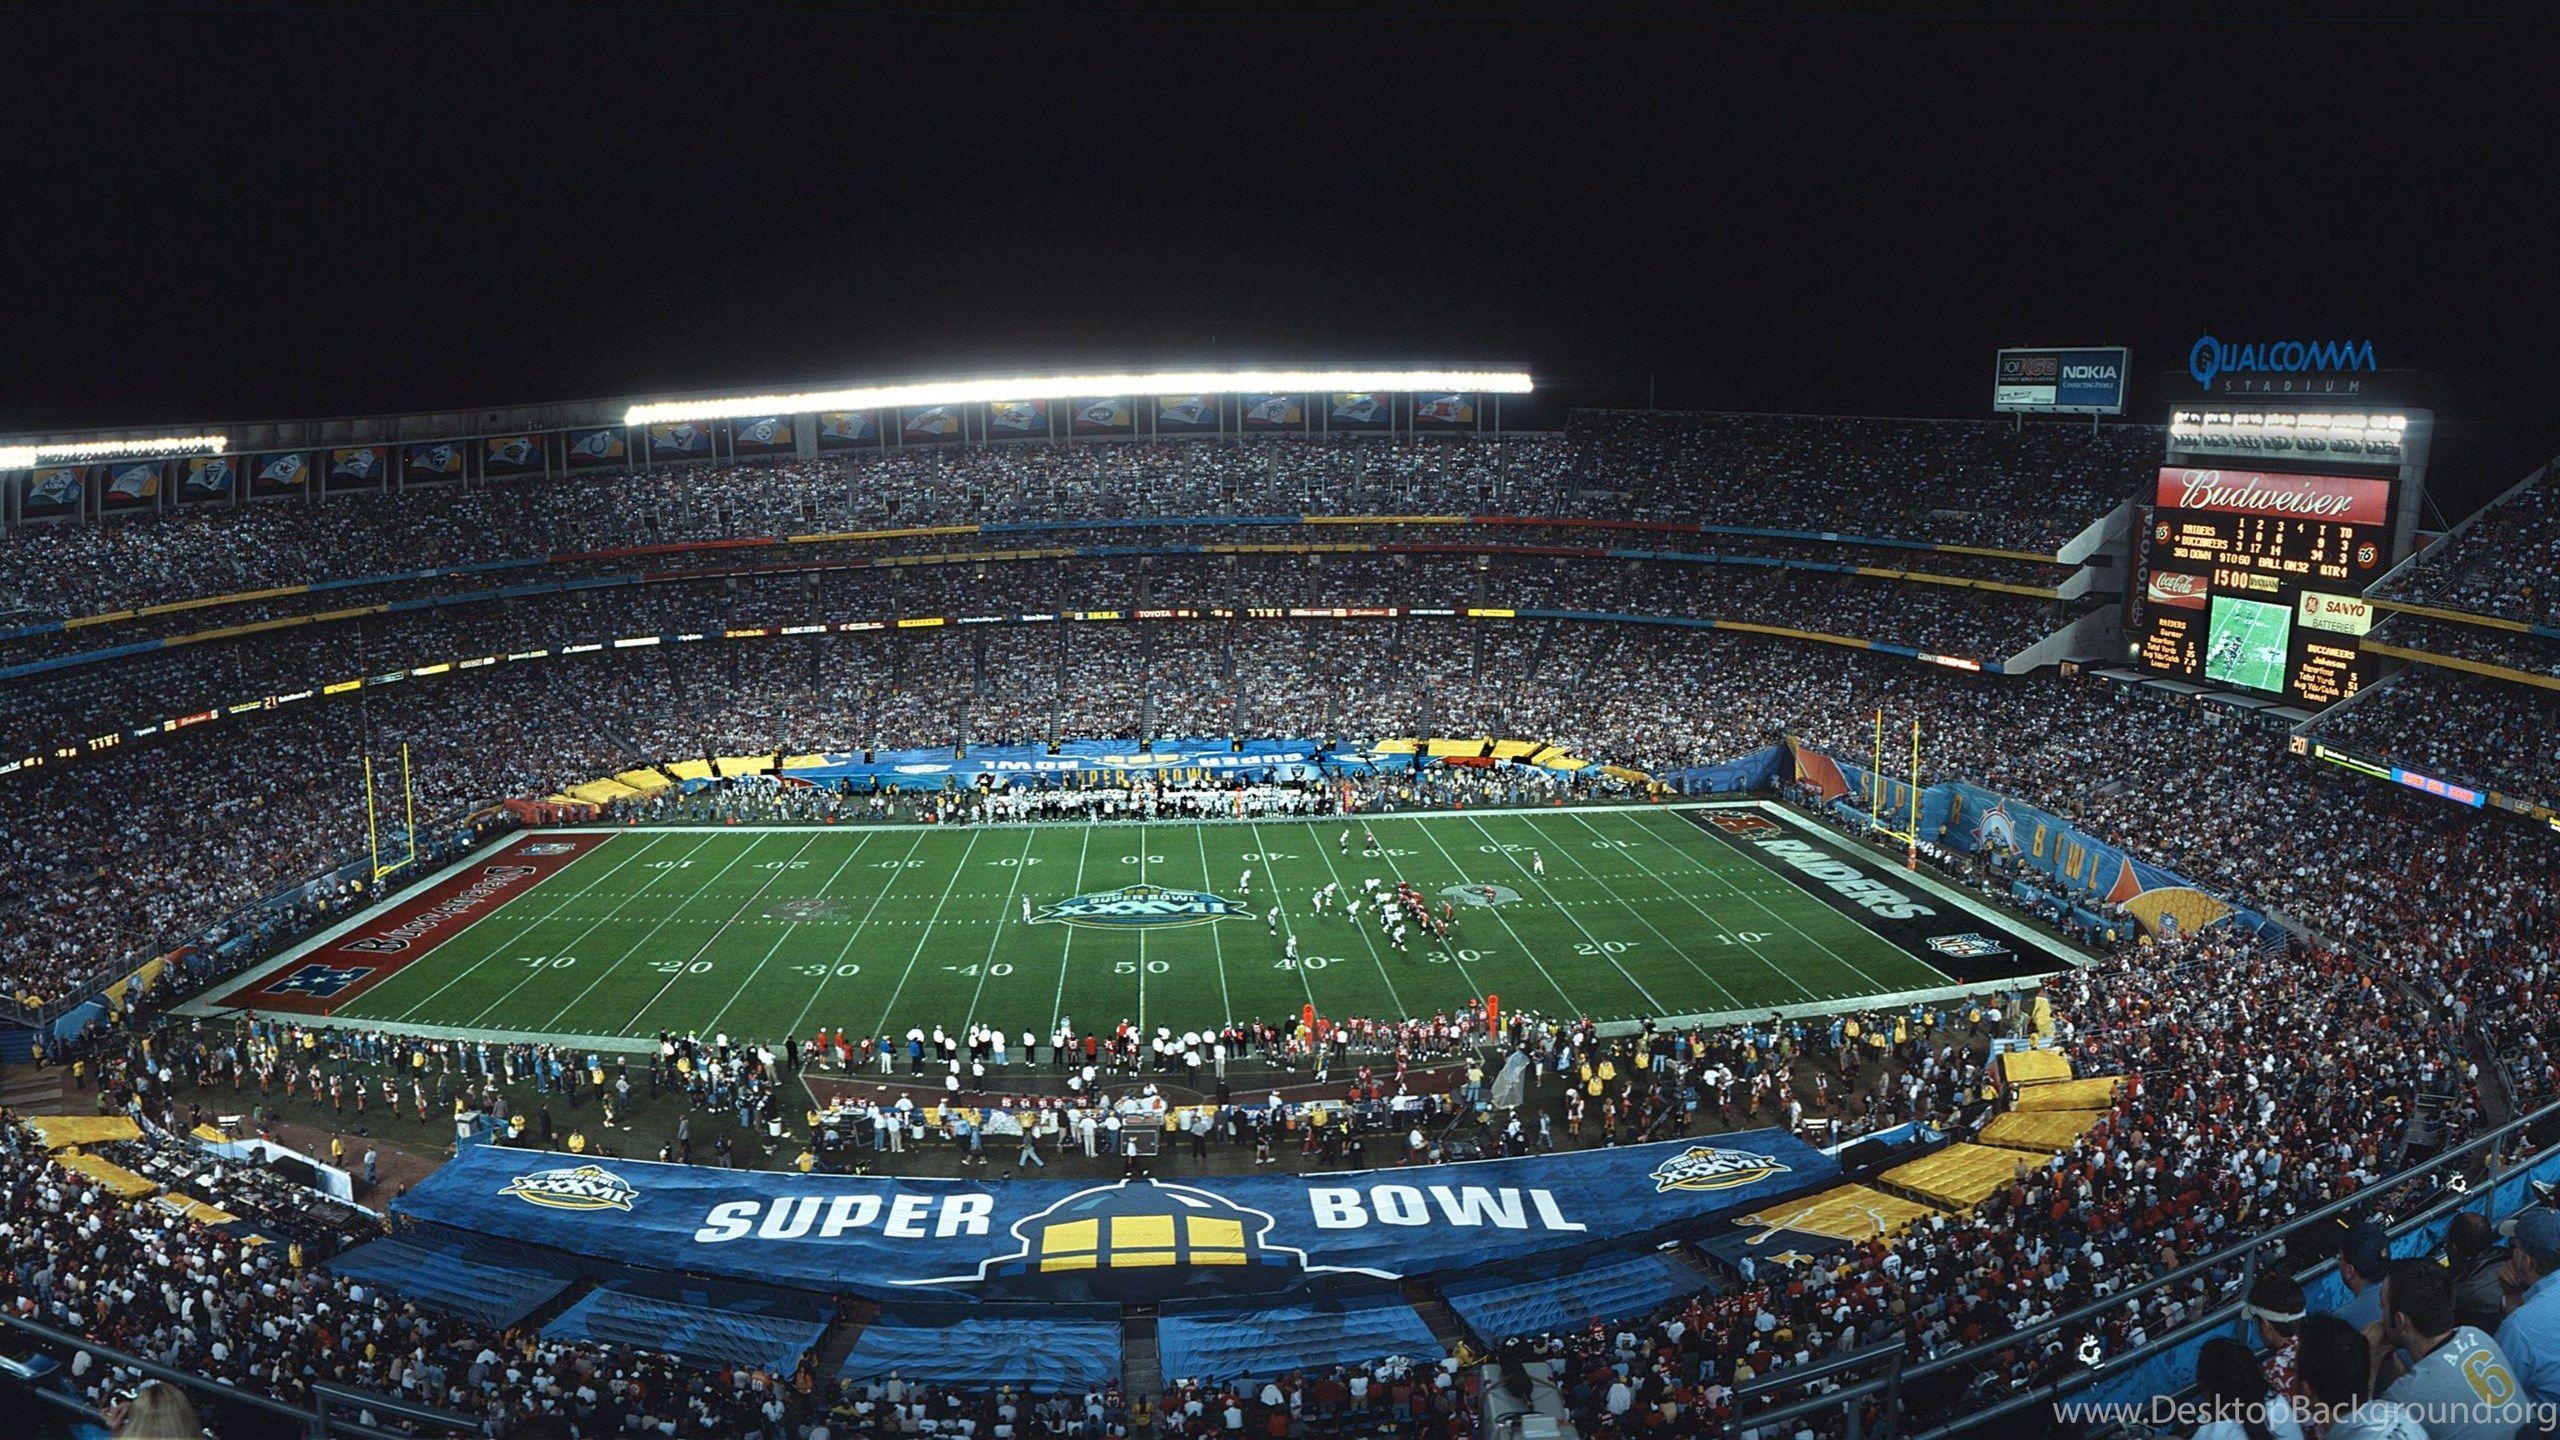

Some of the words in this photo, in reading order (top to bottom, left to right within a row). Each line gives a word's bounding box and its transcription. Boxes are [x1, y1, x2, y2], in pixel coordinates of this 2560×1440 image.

[2190, 336, 2376, 390] QUALCOMM
[2063, 366, 2117, 379] NOKIA
[2224, 380, 2360, 392] STADIUM
[2180, 470, 2353, 516] Budweiser
[2238, 518, 2245, 528] 1
[2257, 519, 2264, 530] 2
[2277, 521, 2285, 532] 3
[2298, 523, 2304, 534] 4
[2183, 524, 2215, 536] RAIDERS
[2237, 530, 2244, 540] 3
[2341, 540, 2349, 551] 3
[2136, 512, 2154, 594] TOYOTA
[2181, 536, 2228, 550] BUCCANEERS
[2236, 541, 2243, 552] 3
[2250, 543, 2261, 554] 17
[2270, 545, 2281, 556] 14
[2311, 550, 2323, 561] 34
[2340, 552, 2347, 564] 3
[2357, 546, 2376, 563] 76
[2190, 549, 2212, 560] DOWN
[2258, 558, 2281, 570] BALL
[1087, 611, 1119, 620] IKEA
[1138, 610, 1171, 618] TOYOTA
[2326, 600, 2365, 617] SANYO
[2159, 618, 2187, 630] RAIDERS
[2313, 619, 2355, 634] BATTERIES
[2307, 644, 2356, 660] BUCCANEERS
[265, 696, 277, 710] 21
[2292, 736, 2306, 753] 20
[980, 760, 1079, 770] BOWL
[1199, 753, 1304, 766] SUPER
[1479, 844, 1522, 854] 20
[1121, 855, 1165, 864] 50
[1754, 839, 1936, 919] RAIDERS
[1088, 894, 1143, 904] SUPER
[1147, 893, 1197, 902] BOWL
[1714, 932, 1762, 946] 10
[1427, 949, 1481, 964] 30
[1573, 941, 1630, 957] 20
[526, 956, 577, 969] 10
[657, 961, 714, 974] 20
[803, 963, 860, 977] 30
[962, 963, 1014, 977] 40
[1114, 961, 1170, 973] 50
[1274, 957, 1328, 969] 40
[1673, 1157, 1708, 1170] SUPER
[1708, 1153, 1741, 1164] BOWL
[548, 1172, 585, 1182] SUPER
[586, 1175, 615, 1187] BOWL
[695, 1194, 994, 1243] SUPER
[1308, 1185, 1588, 1233] BOWL
[2443, 1333, 2479, 1367] ALI
[2461, 1350, 2516, 1409] 6
